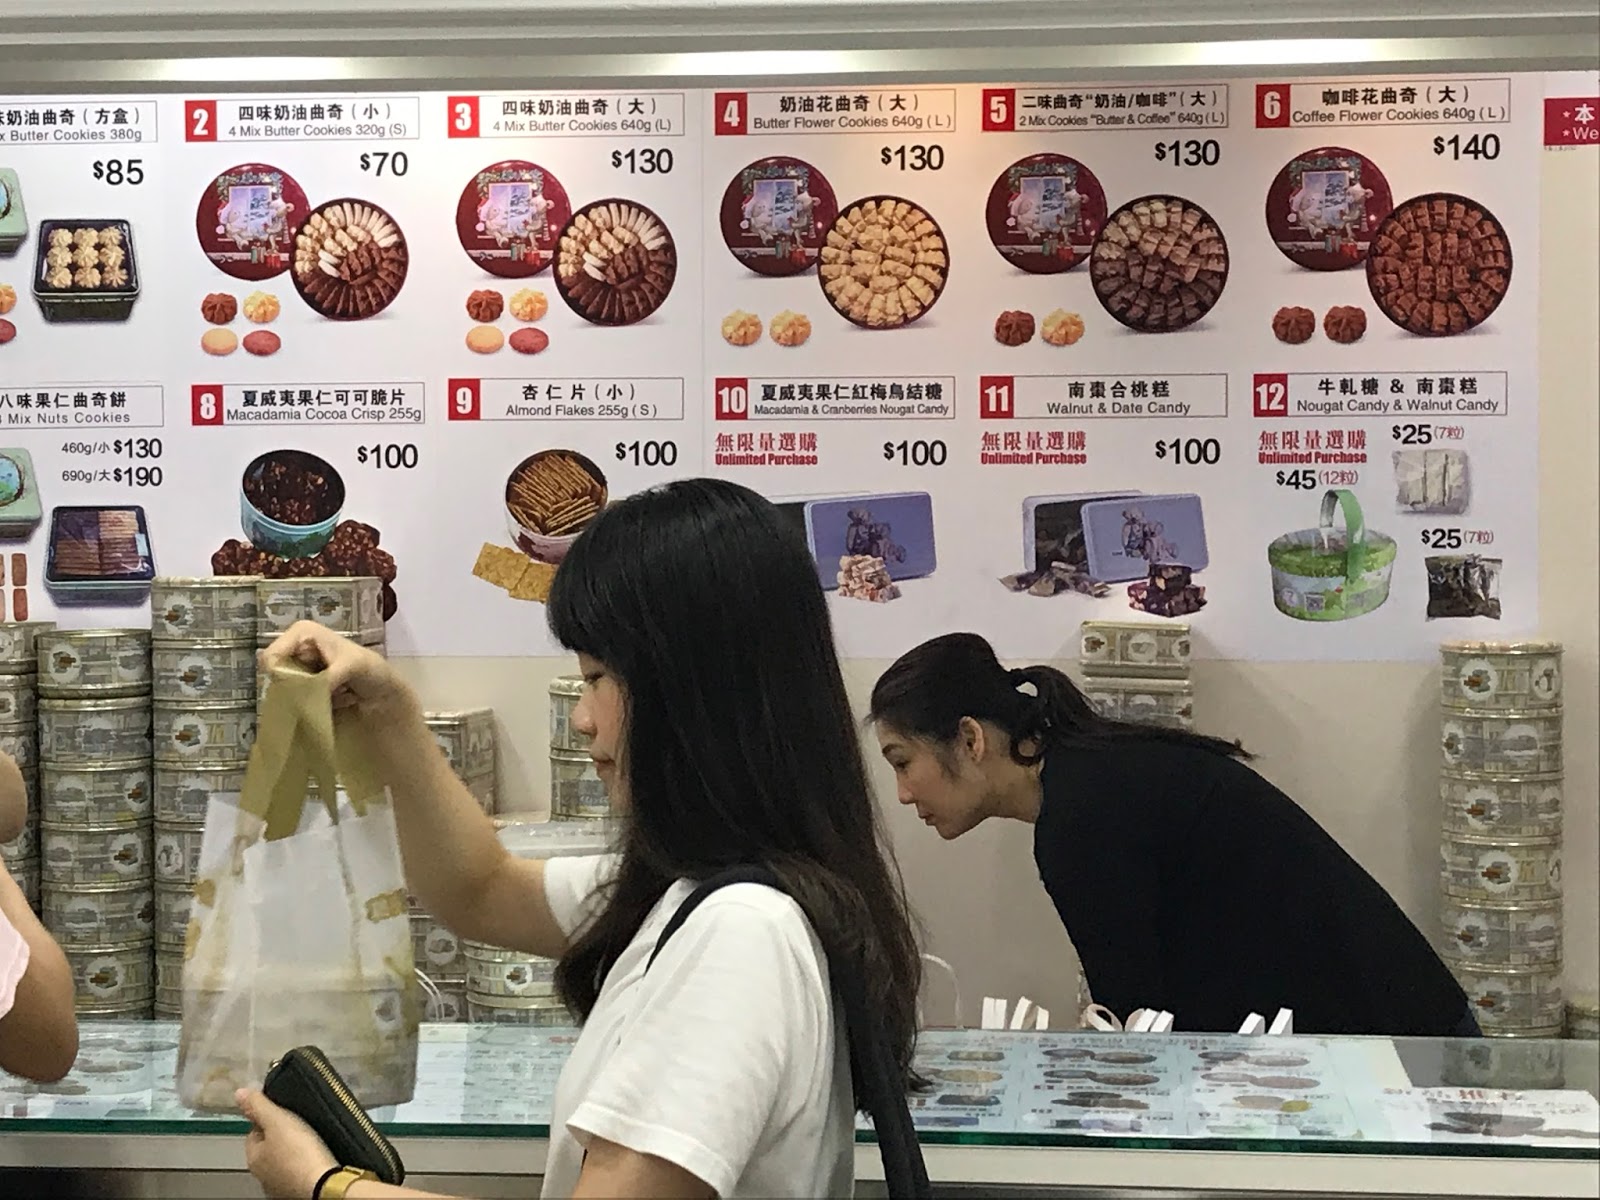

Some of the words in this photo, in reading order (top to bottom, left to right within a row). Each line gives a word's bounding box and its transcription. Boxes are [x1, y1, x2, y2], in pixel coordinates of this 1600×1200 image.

[723, 100, 740, 127] 4
[990, 96, 1007, 124] 5
[1264, 91, 1281, 119] 6
[1292, 109, 1335, 123] Coffee
[1339, 108, 1382, 122] Flower
[1385, 107, 1438, 121] Cookies
[1443, 107, 1475, 121] 640g
[1574, 103, 1595, 125] 本
[193, 108, 209, 136] 2
[455, 103, 472, 130] 3
[493, 122, 500, 131] 4
[504, 121, 526, 132] Mix
[529, 120, 565, 132] Butter
[568, 119, 617, 131] Cookies
[621, 119, 651, 132] 640g
[655, 119, 671, 132] (L)
[753, 117, 790, 129] Butter
[794, 116, 835, 128] Flower
[838, 115, 888, 127] Cookies
[892, 115, 923, 129] 640g
[1019, 115, 1026, 126] 2
[1028, 115, 1046, 126] Mix
[1048, 114, 1088, 126] Cookies
[1127, 113, 1135, 124] &
[1178, 112, 1203, 125] 640g
[10, 129, 49, 142] Butter
[53, 129, 106, 141] Cookies
[110, 128, 142, 143] 380g
[228, 126, 237, 137] 4
[240, 126, 261, 137] Mix
[264, 125, 300, 137] Butter
[303, 124, 352, 136] Cookies
[355, 124, 385, 137] 320g
[389, 123, 407, 136] (S)
[1572, 126, 1600, 140] We
[881, 144, 944, 171] $130
[1155, 139, 1221, 167] $130
[1433, 133, 1501, 161] $140
[360, 151, 409, 176] $70
[611, 148, 674, 174] $130
[92, 159, 144, 186] $85
[1256, 382, 1285, 411] 12
[1390, 379, 1404, 394] &
[200, 393, 217, 420] 8
[242, 388, 406, 407] 夏威夷果仁可可脆片
[456, 386, 473, 414] 9
[718, 386, 746, 414] 10
[984, 385, 1009, 412] 11
[1297, 399, 1344, 413] Nougat
[1347, 399, 1389, 413] Candy
[1394, 399, 1403, 410] &
[1406, 398, 1453, 411] Walnut
[1456, 398, 1498, 413] Candy
[8, 413, 31, 424] Mix
[37, 413, 68, 424] Nuts
[74, 412, 130, 424] Cookies
[226, 407, 301, 421] Macadamia
[305, 408, 347, 420] Cocoa
[351, 407, 385, 422] Crisp
[389, 407, 422, 422] 255g
[506, 404, 552, 416] Almond
[555, 404, 594, 416] Flakes
[598, 404, 628, 418] 255g
[754, 404, 810, 415] Macadamia
[811, 404, 819, 414] &
[821, 403, 877, 415] Cranberries
[880, 403, 915, 417] Nougat
[917, 403, 949, 416] Candy
[1047, 402, 1095, 414] Walnut
[1097, 402, 1107, 414] &
[1112, 402, 1143, 414] Date
[1147, 401, 1190, 416] Candy
[715, 432, 818, 452] 無限量選購
[981, 431, 1086, 451] 無限量選購
[1258, 429, 1367, 450] 無限量選購
[1392, 424, 1432, 445] $25
[113, 438, 163, 458] $130
[357, 443, 419, 469] $100
[615, 440, 678, 466] $100
[883, 439, 947, 466] $100
[981, 452, 1033, 465] Unlimited
[1035, 452, 1086, 465] Purchase
[1155, 438, 1221, 465] $100
[1258, 451, 1312, 464] Unlimited
[1314, 451, 1367, 464] Purchase
[715, 453, 766, 466] Unlimited
[768, 453, 818, 466] Purchase
[113, 466, 163, 486] $190
[1276, 469, 1317, 490] $45
[1421, 528, 1462, 549] $25
